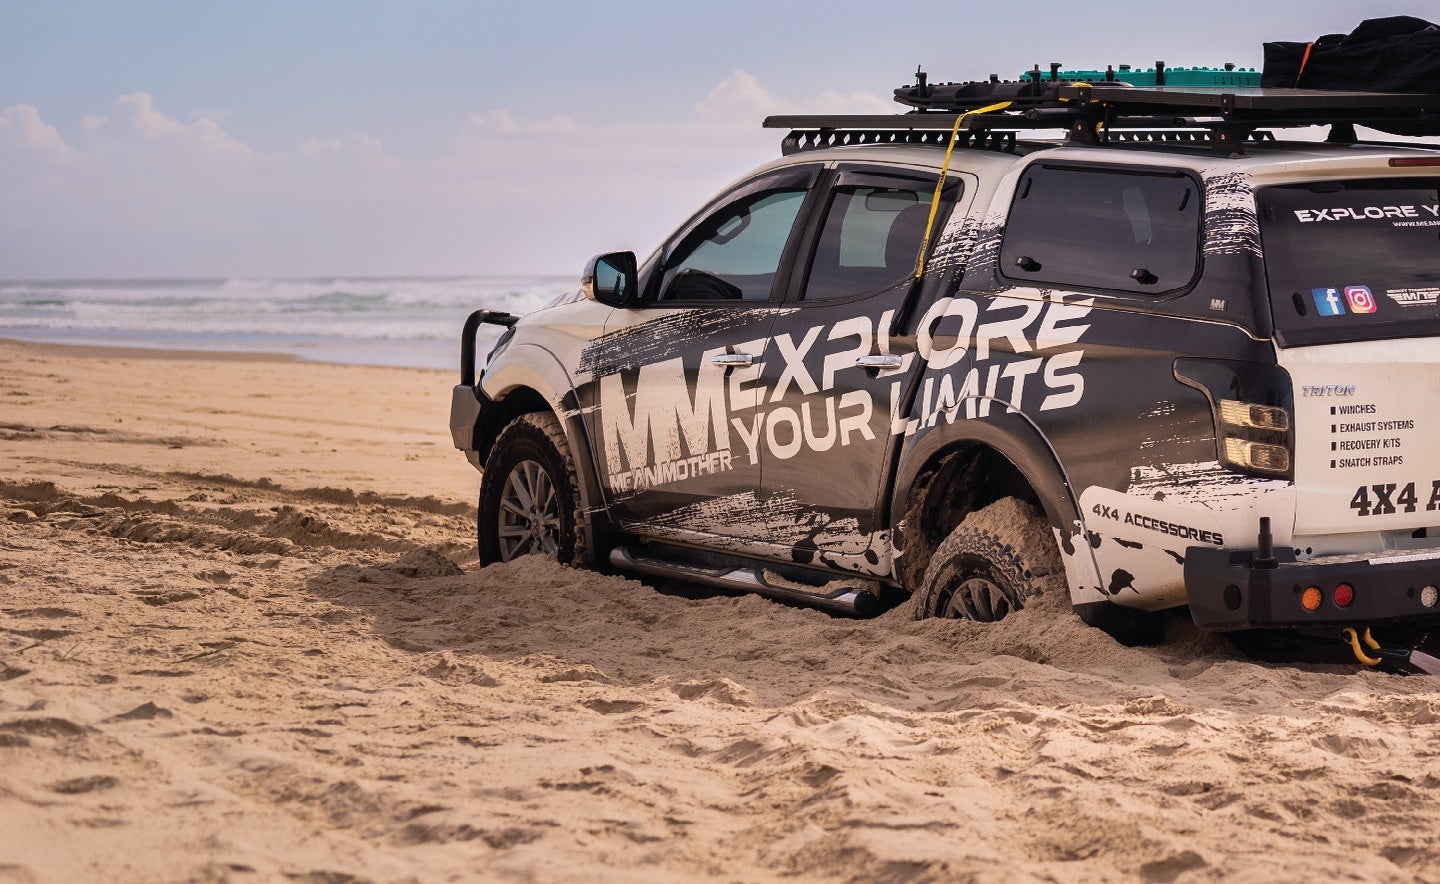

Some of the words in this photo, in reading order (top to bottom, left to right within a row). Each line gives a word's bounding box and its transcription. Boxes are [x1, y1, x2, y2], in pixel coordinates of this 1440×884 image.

[1294, 205, 1419, 223] EXPLORE
[729, 287, 1096, 407] EXPLORE
[1302, 385, 1357, 397] TRITON
[600, 344, 732, 474] MM
[731, 389, 876, 466] YOUR
[890, 349, 1086, 438] LIMITS
[1339, 404, 1376, 415] WINCHES
[1340, 422, 1376, 433] EXHAUST
[1377, 420, 1415, 431] SYSTEMS
[1340, 439, 1381, 451] RECOVERY
[1383, 438, 1401, 448] KITS
[608, 464, 662, 495] MEAN
[661, 449, 734, 483] MOTHER
[1339, 457, 1371, 468] SNATCH
[1373, 455, 1404, 467] STRAPS
[1350, 482, 1418, 517] 4X4
[1092, 503, 1120, 521] 4X4
[1124, 512, 1224, 545] ACCESSORIES
